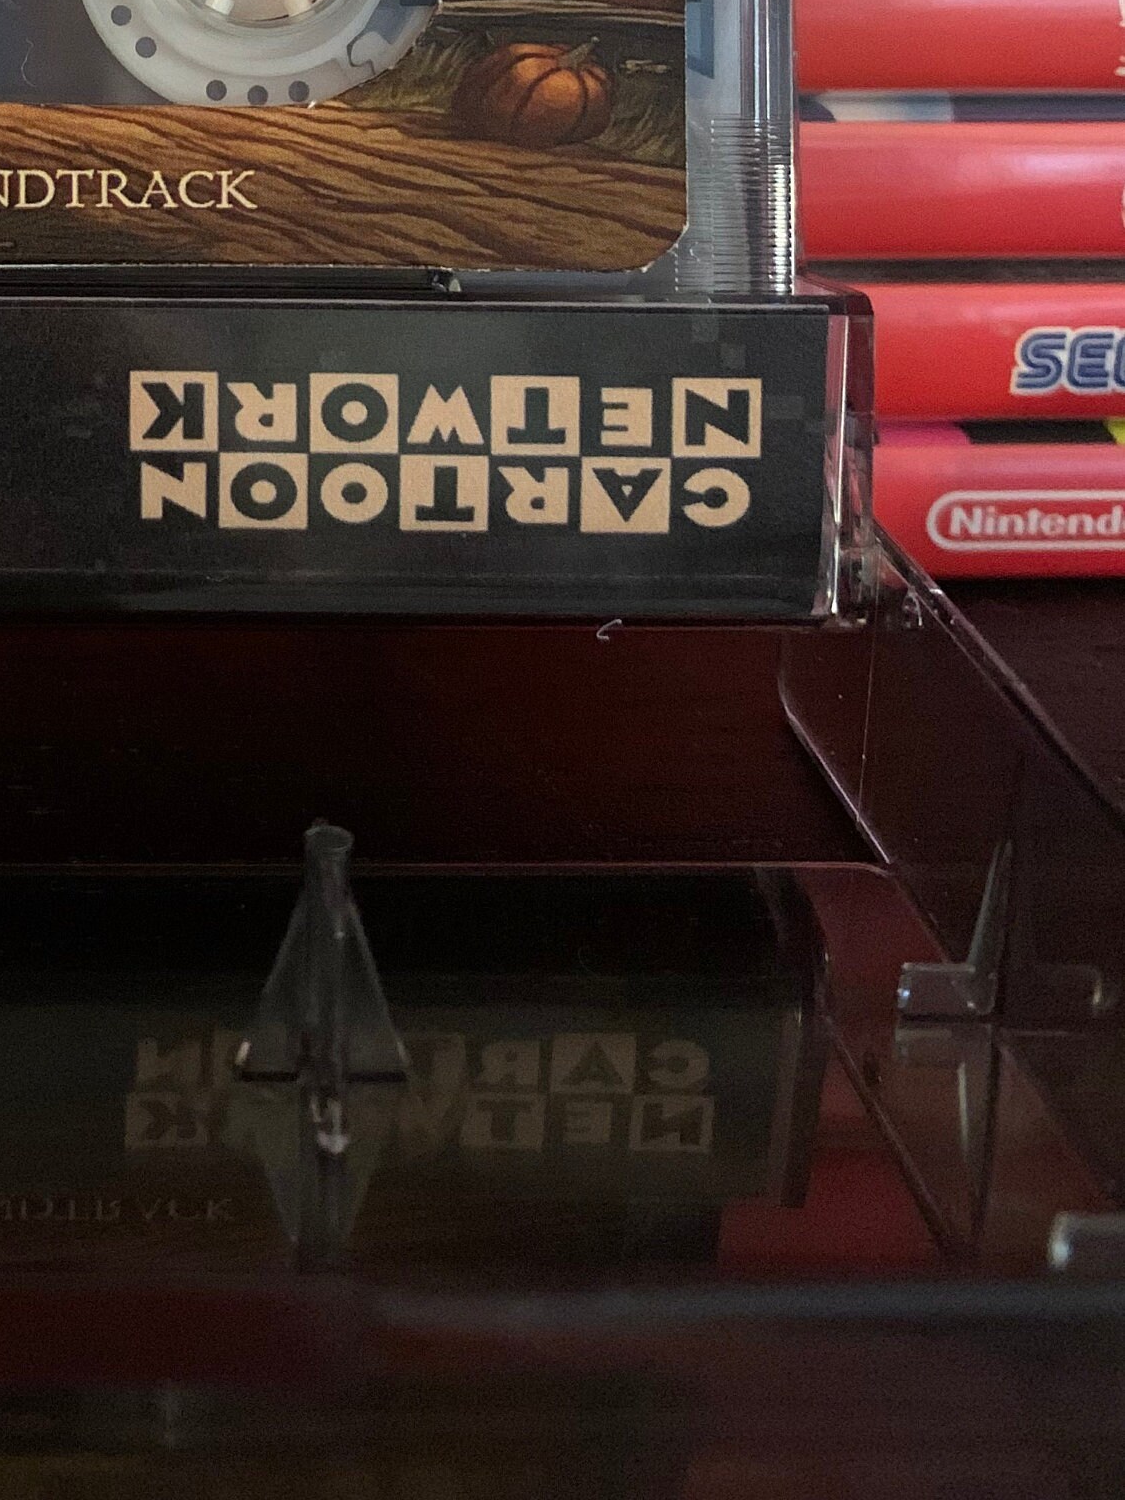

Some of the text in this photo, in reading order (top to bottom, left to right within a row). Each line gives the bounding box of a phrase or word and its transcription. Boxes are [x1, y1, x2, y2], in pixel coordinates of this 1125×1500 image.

[1013, 329, 1125, 392] SE
[129, 369, 763, 459] NETWORK
[138, 453, 753, 534] CARTOON
[949, 506, 1125, 537] Nintend
